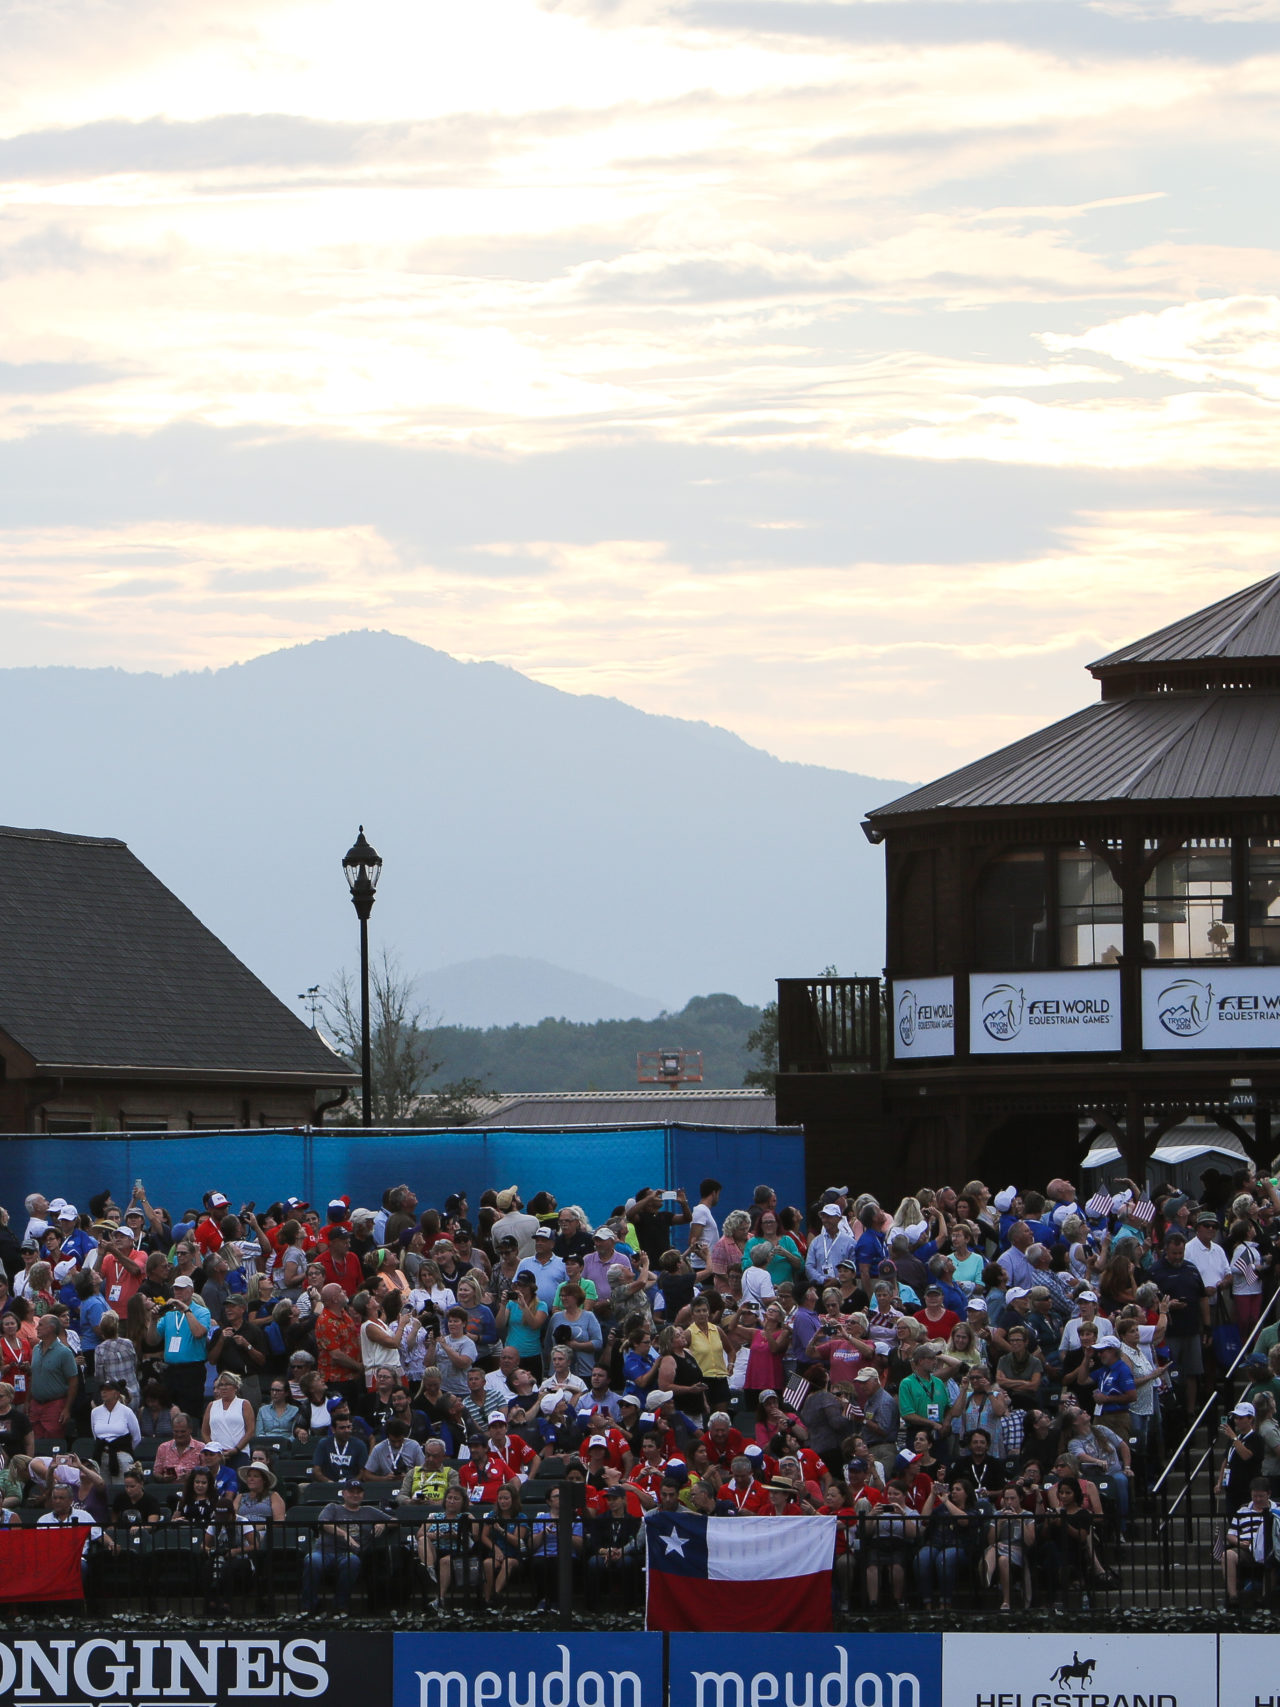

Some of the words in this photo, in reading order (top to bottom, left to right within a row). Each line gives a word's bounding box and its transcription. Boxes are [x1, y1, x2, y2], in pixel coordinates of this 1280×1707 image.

[1027, 1000, 1059, 1014] FEI
[1063, 1000, 1110, 1014] WORLD
[1216, 996, 1258, 1010] FEI
[1263, 995, 1280, 1009] W
[918, 1005, 932, 1020] FEI
[933, 1004, 953, 1018] WORLD
[1028, 1015, 1080, 1025] EQUESTRIAN
[1232, 1095, 1253, 1104] ATM
